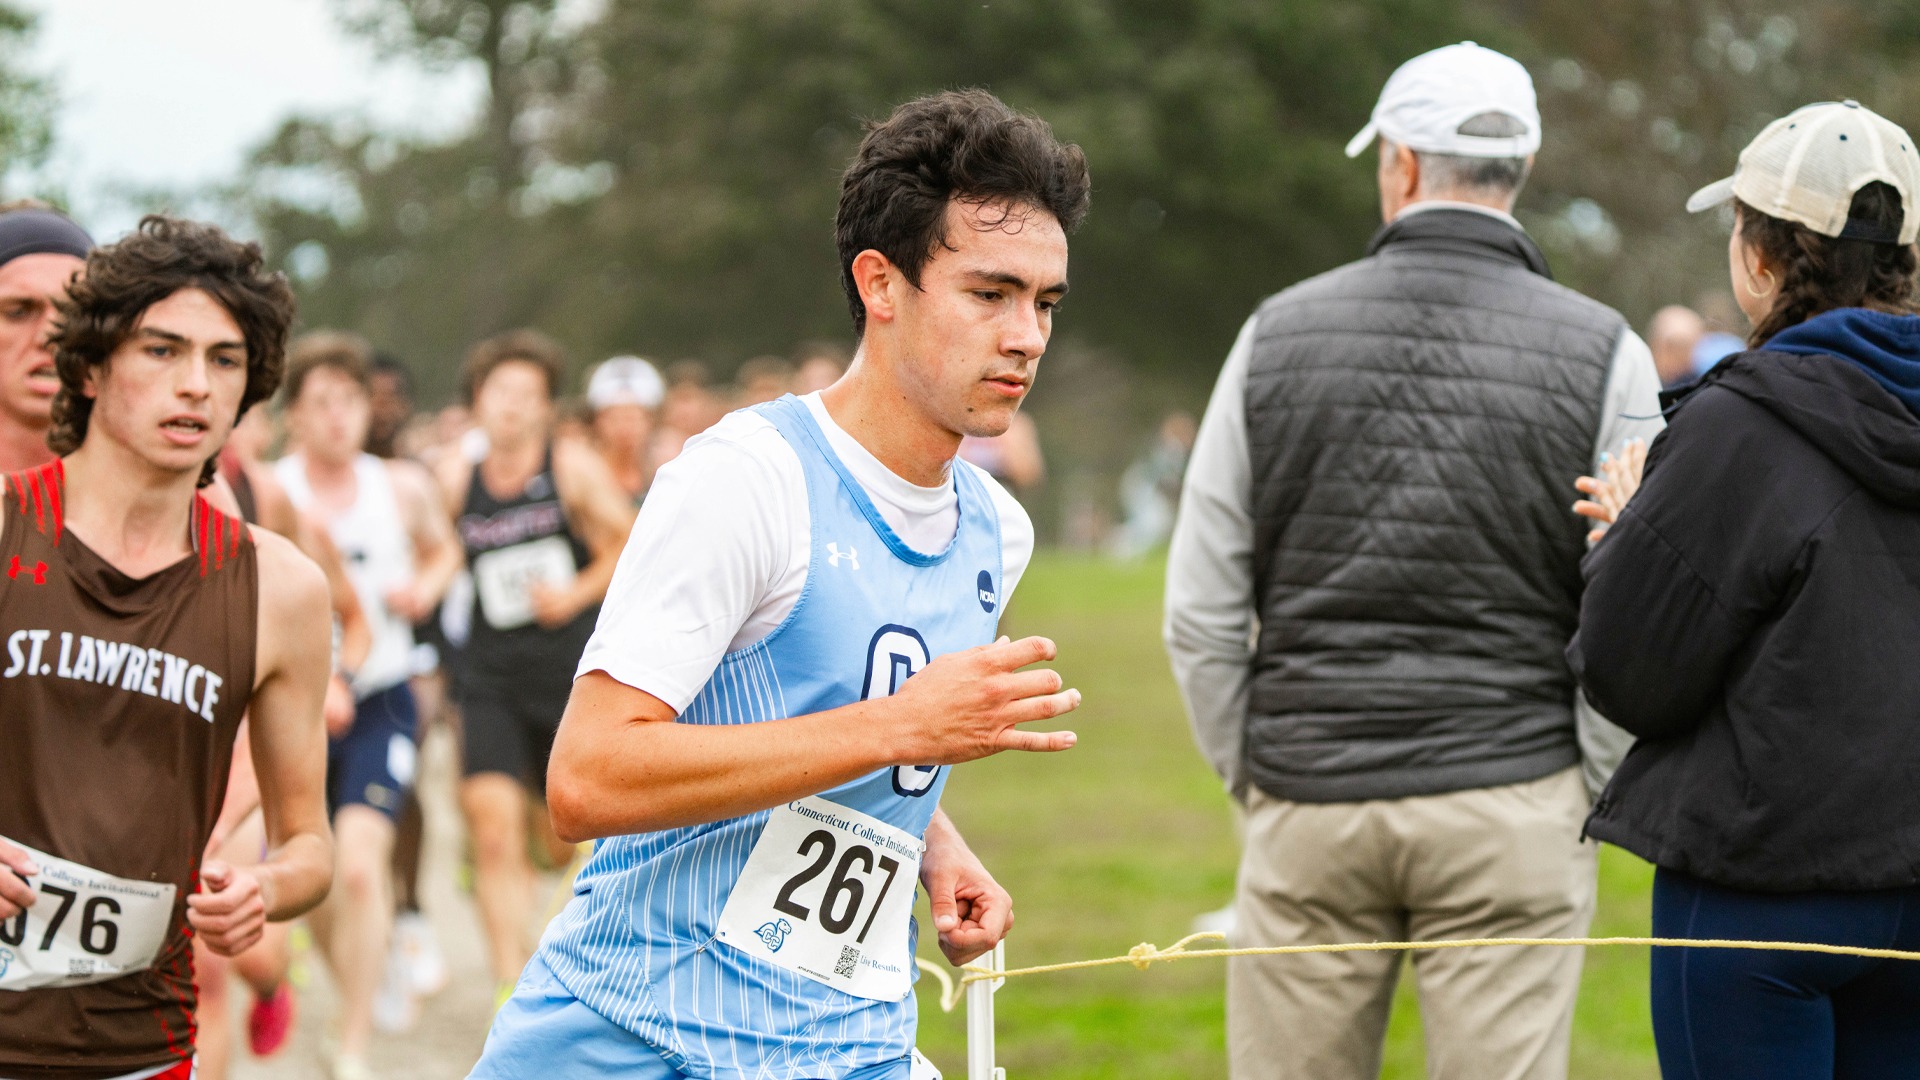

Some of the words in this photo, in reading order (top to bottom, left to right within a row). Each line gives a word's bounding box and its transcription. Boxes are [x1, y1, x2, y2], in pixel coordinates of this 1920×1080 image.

[4, 630, 50, 678] ST.
[57, 632, 223, 723] LAWRENCE
[788, 800, 850, 832] Connecticut
[852, 823, 885, 846] College
[42, 865, 83, 886] College
[88, 879, 160, 899] Invitational
[773, 829, 899, 944] 267
[872, 959, 902, 973] Results
